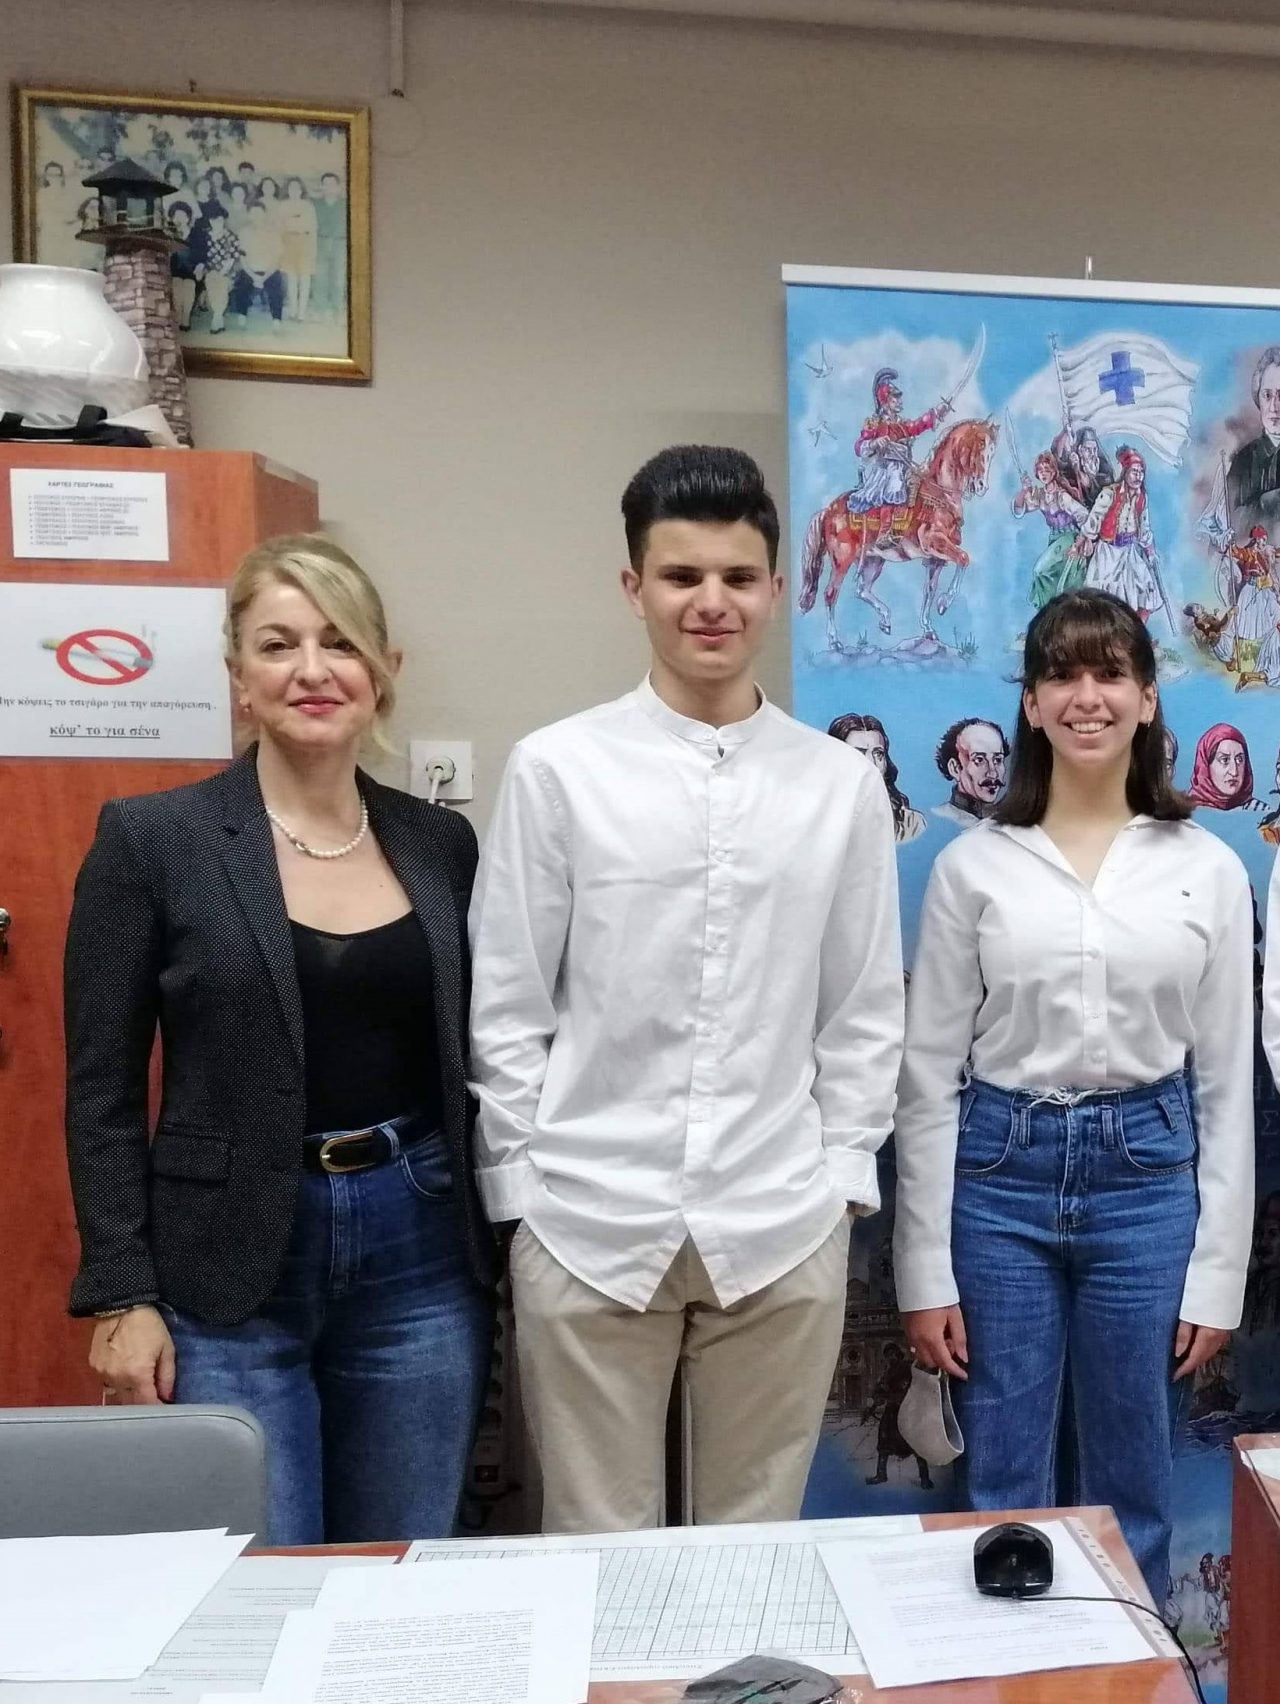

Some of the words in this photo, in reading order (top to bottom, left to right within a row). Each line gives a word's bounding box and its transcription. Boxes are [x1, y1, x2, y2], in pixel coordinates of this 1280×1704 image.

[111, 699, 127, 709] για
[130, 700, 147, 710] την
[86, 726, 101, 735] το
[104, 727, 125, 738] για
[129, 724, 160, 736] σένα
